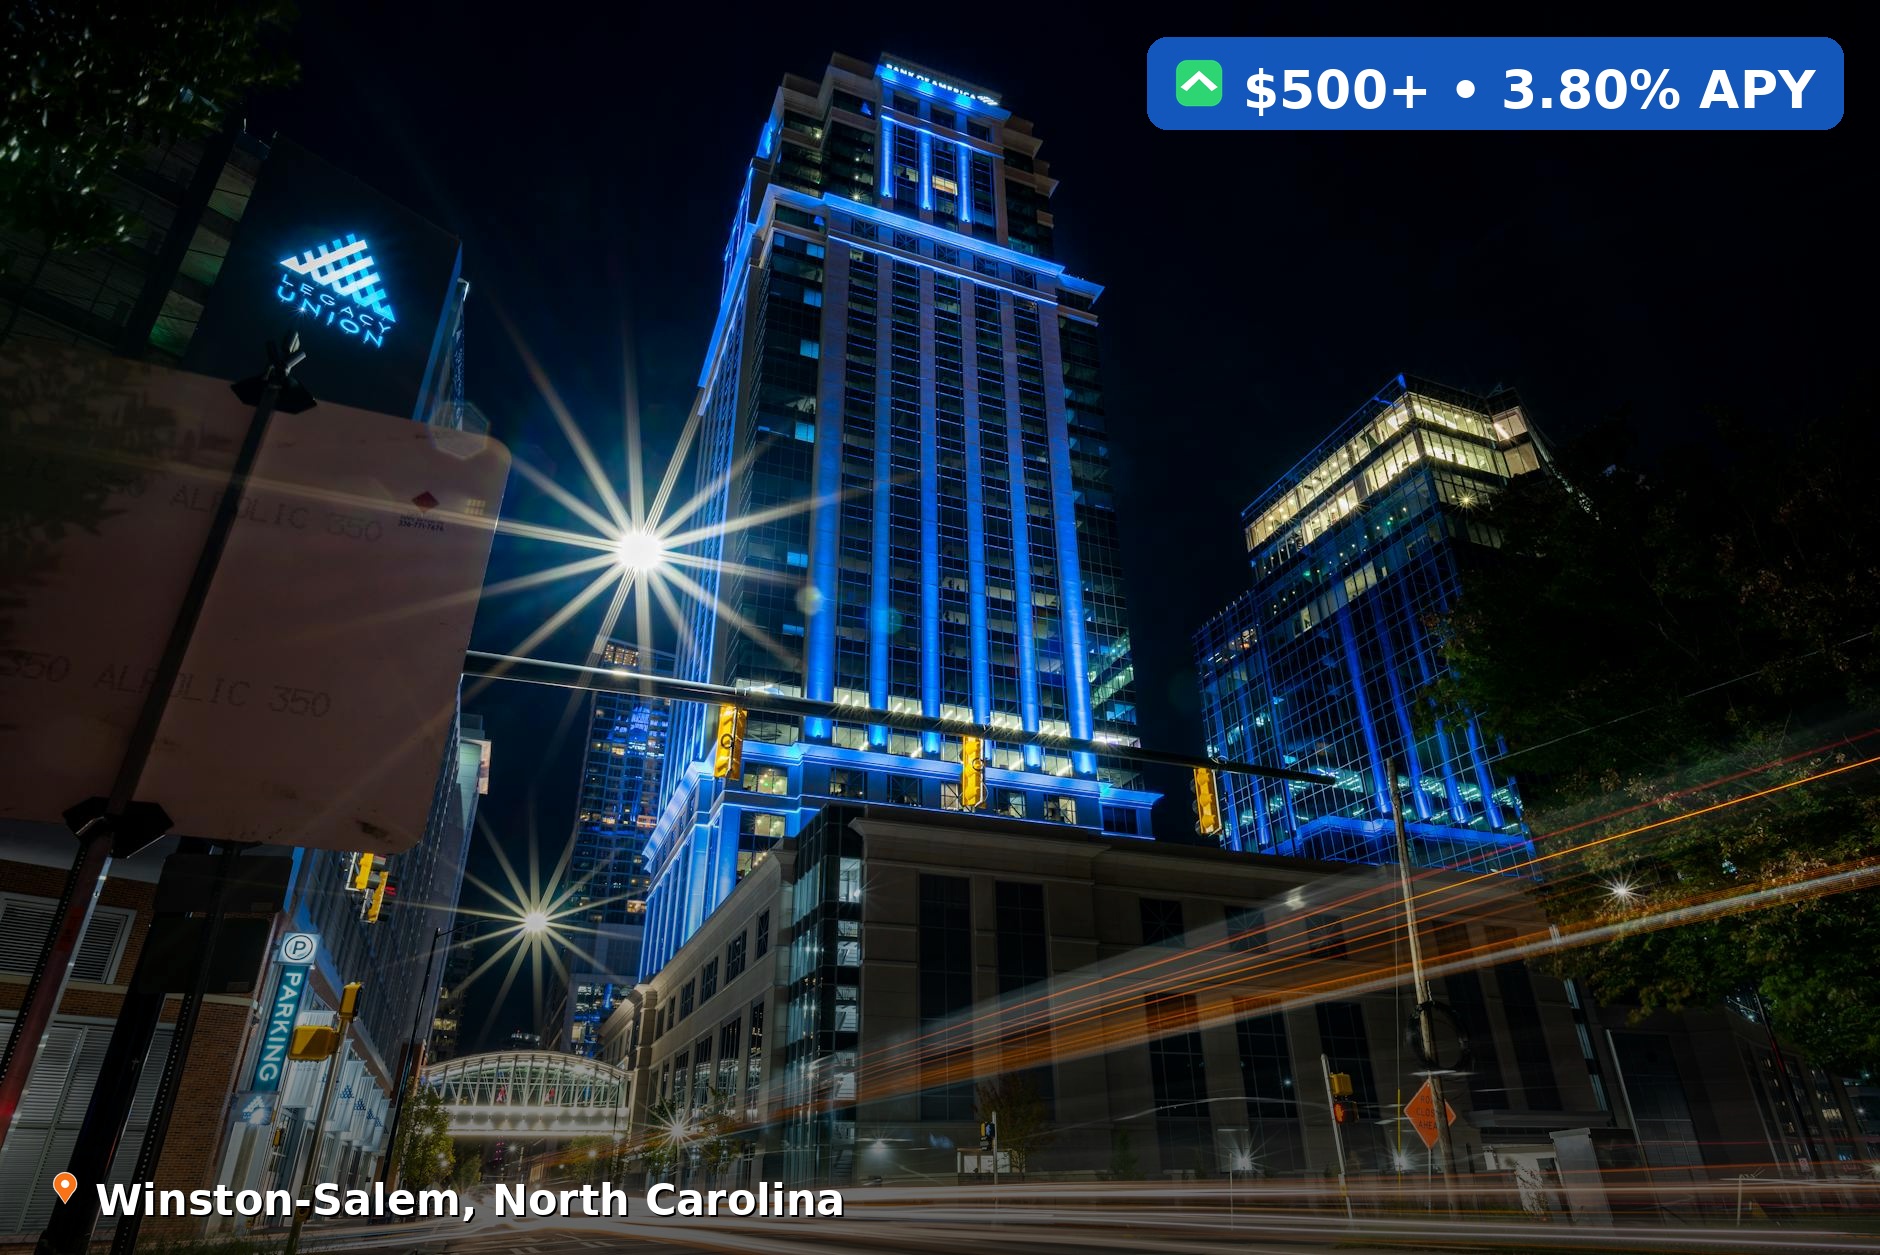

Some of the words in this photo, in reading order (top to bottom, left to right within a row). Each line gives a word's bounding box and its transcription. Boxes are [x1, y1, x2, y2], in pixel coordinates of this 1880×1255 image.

[885, 63, 915, 77] BANK
[917, 74, 931, 83] OF
[931, 79, 976, 99] AMERICA
[277, 285, 383, 348] UNION
[281, 273, 391, 334] LEGACY
[325, 507, 384, 542] 350
[267, 684, 332, 718] 350
[292, 940, 308, 955] P
[259, 972, 303, 1081] PARKING
